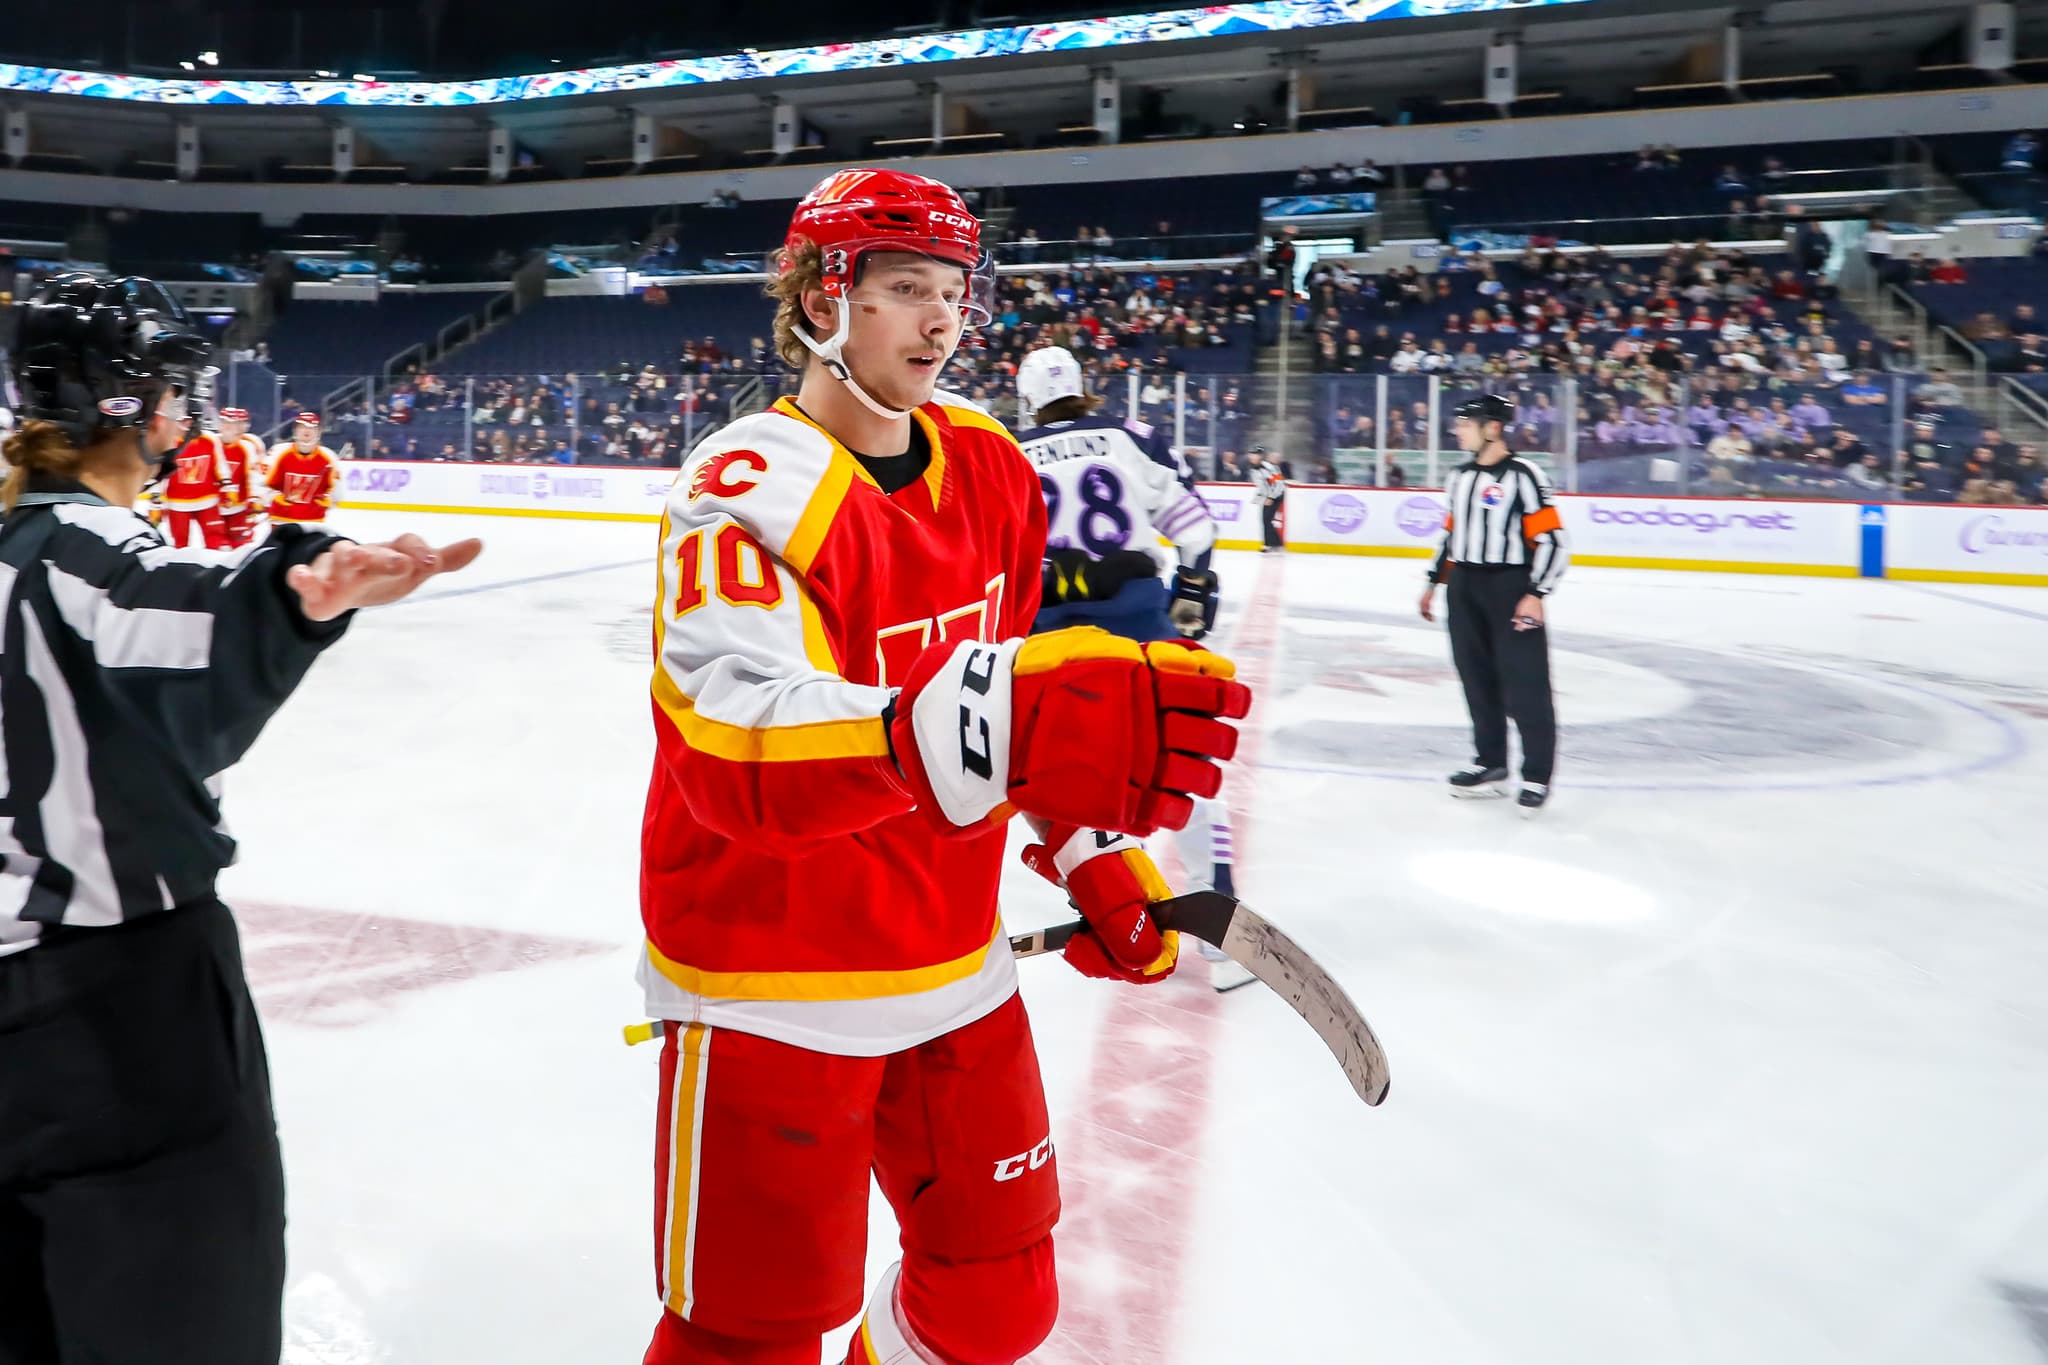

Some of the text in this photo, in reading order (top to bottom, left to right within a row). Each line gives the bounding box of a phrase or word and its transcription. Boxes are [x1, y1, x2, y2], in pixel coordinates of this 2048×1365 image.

[928, 209, 973, 230] CCM
[1024, 435, 1110, 465] TENLUND
[365, 468, 411, 492] SKIP
[1589, 502, 1797, 533] bodog.net
[675, 521, 784, 621] 10
[960, 648, 997, 782] CC
[1129, 910, 1147, 944] CCM
[993, 1135, 1054, 1182] CC
